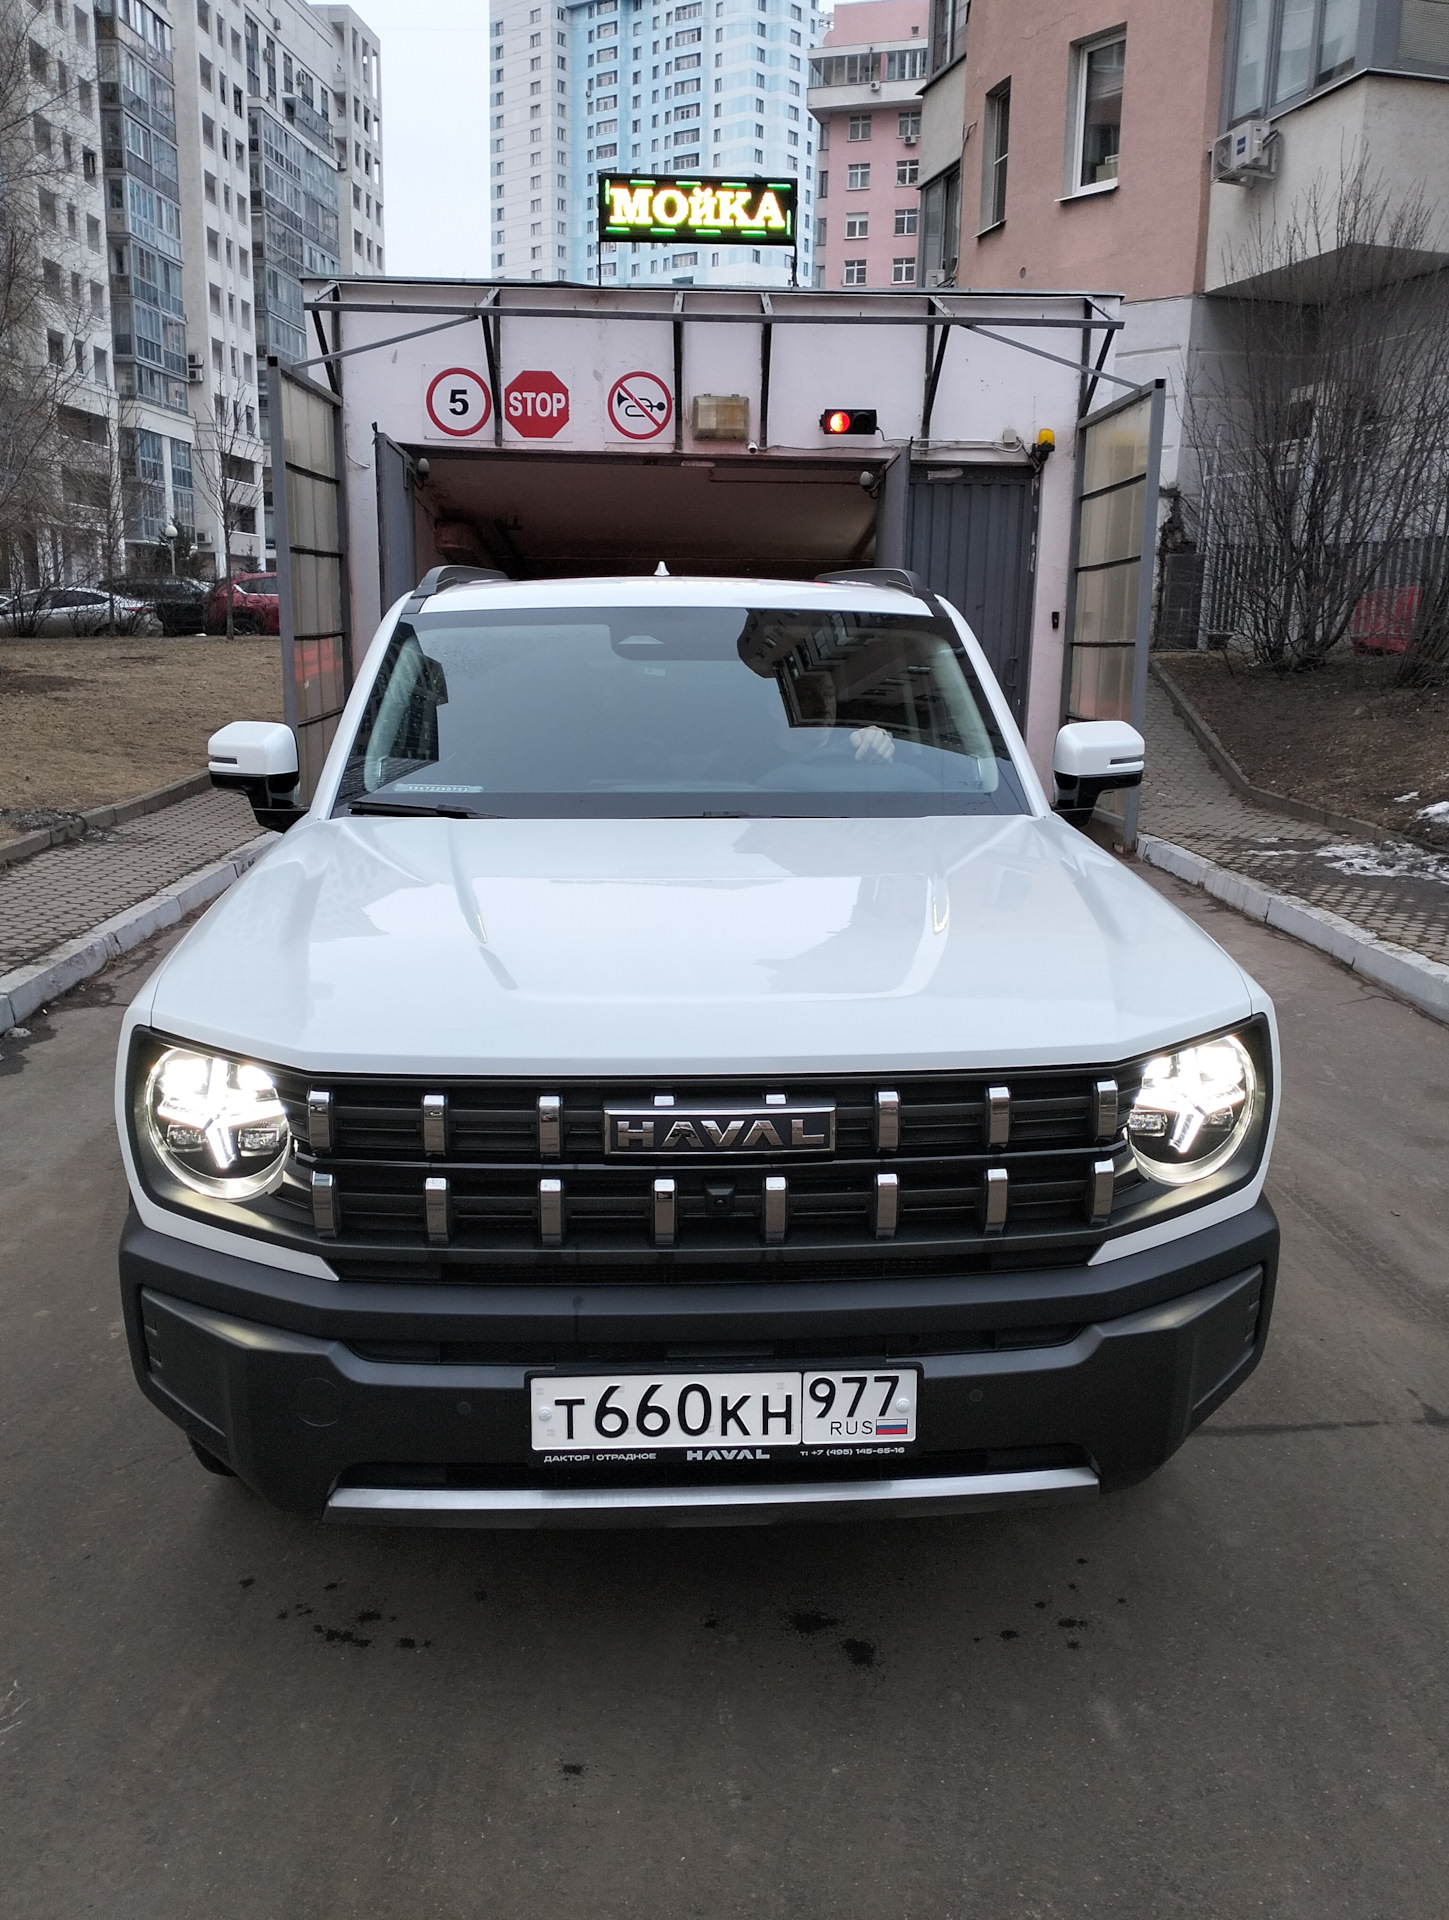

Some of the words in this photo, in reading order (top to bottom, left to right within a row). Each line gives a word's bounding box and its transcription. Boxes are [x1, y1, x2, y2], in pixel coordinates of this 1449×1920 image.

[449, 389, 469, 416] 5
[508, 391, 566, 418] STOP
[617, 1119, 825, 1148] HAVAL
[554, 1382, 792, 1440] Т660КН
[809, 1376, 900, 1419] 977
[830, 1421, 873, 1436] RUS
[544, 1454, 590, 1463] ДАКТОР
[596, 1452, 657, 1462] ОТРАДНОЕ
[686, 1449, 770, 1461] HAVAL
[826, 1448, 853, 1456] (495)
